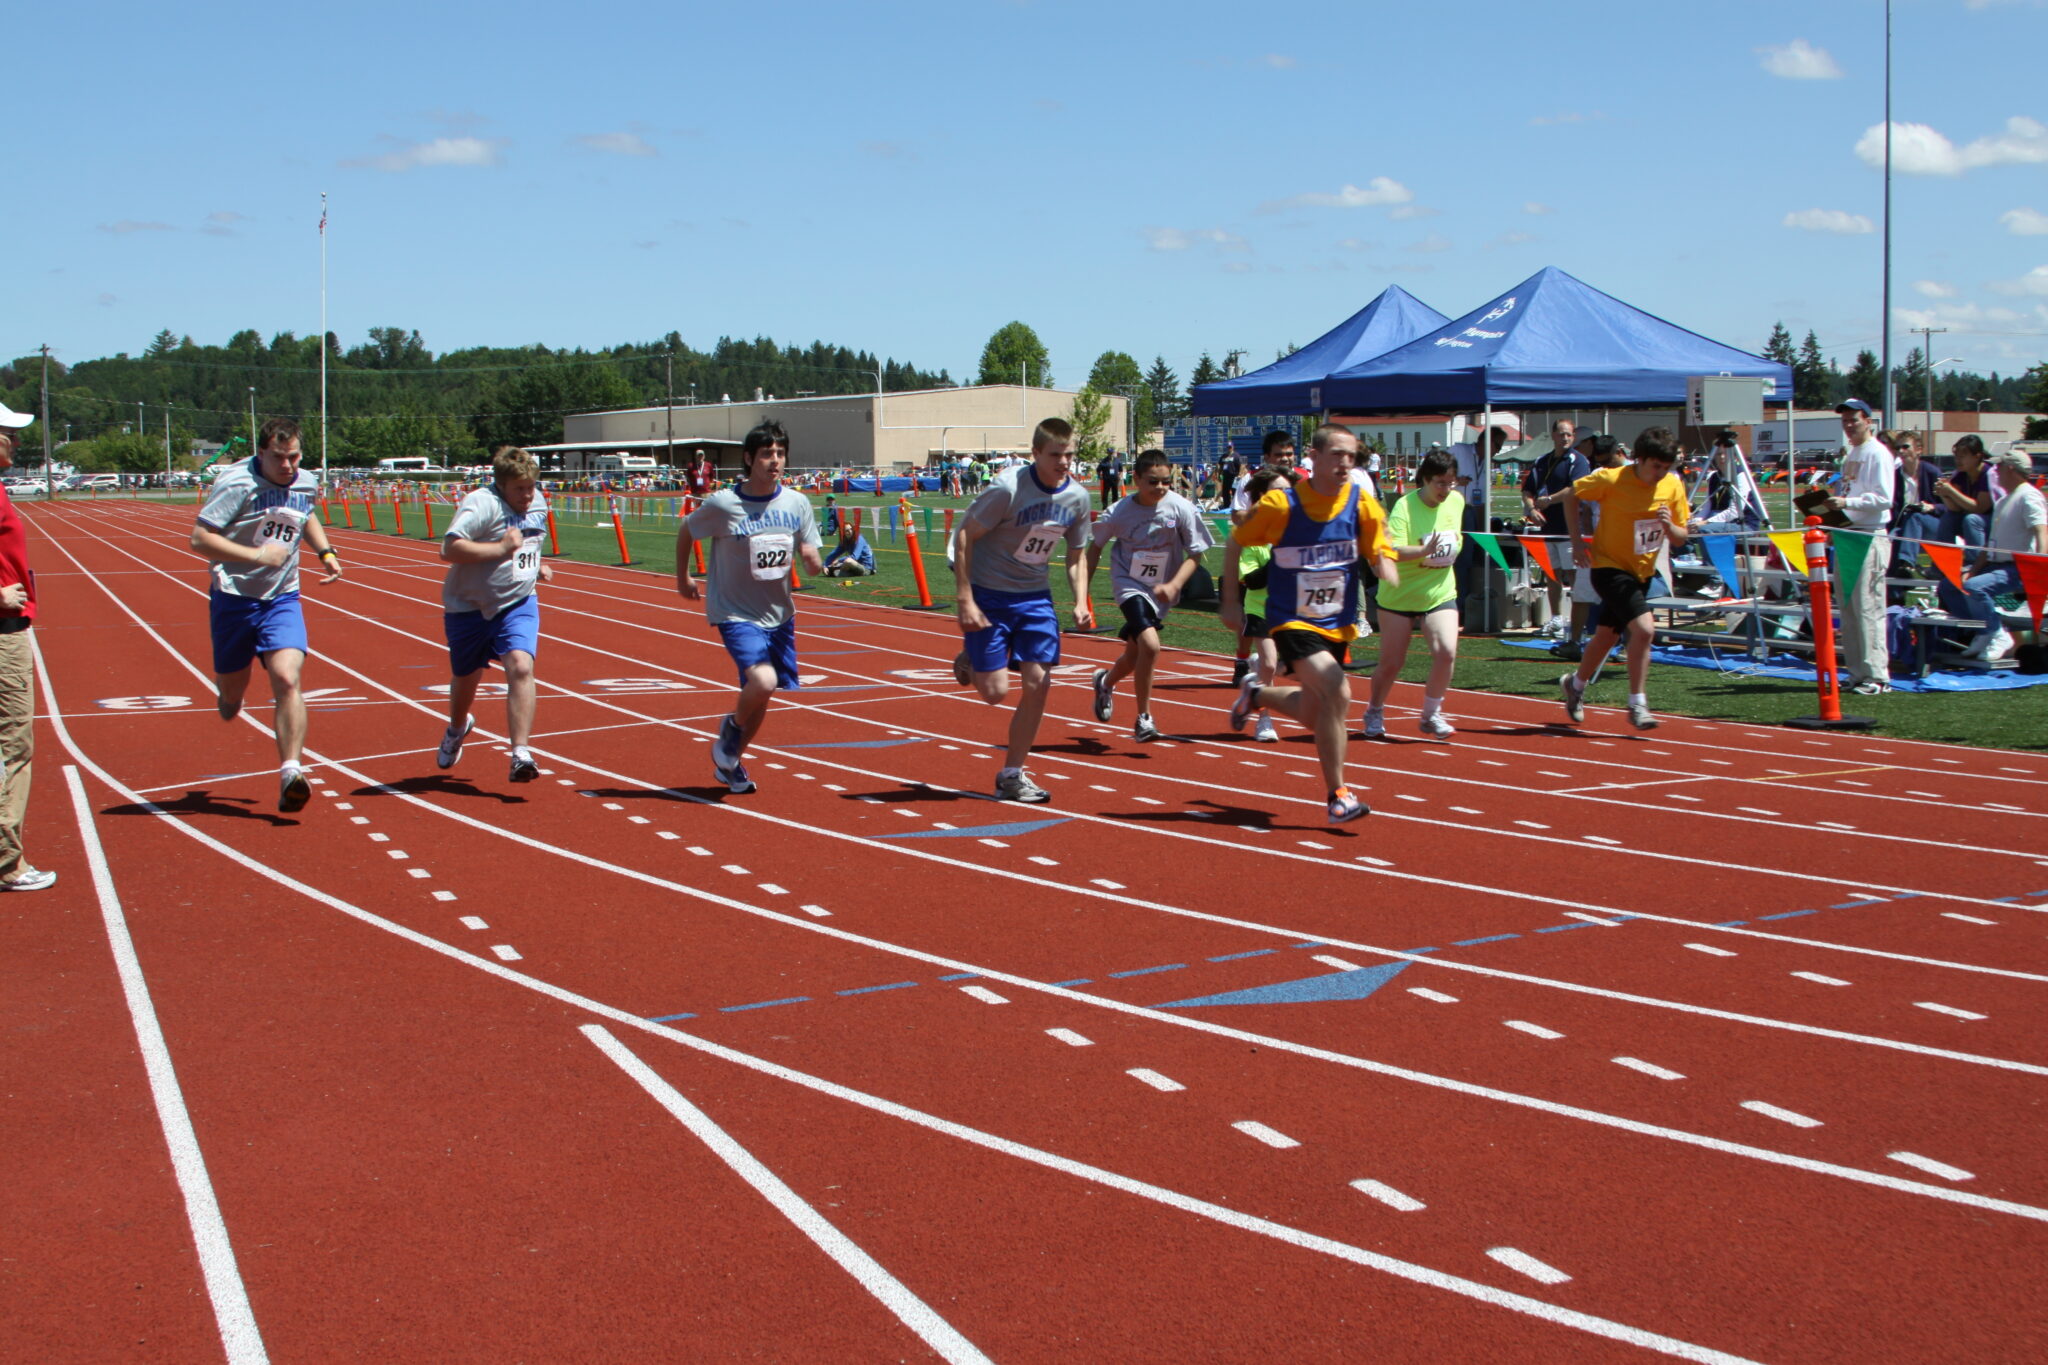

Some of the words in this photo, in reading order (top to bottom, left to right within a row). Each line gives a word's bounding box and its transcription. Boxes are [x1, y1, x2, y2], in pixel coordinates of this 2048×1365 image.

[262, 520, 296, 543] 315
[1640, 529, 1662, 546] 147
[1024, 537, 1054, 555] 314
[1298, 543, 1354, 567] TAHOMA
[518, 552, 536, 570] 311
[757, 550, 787, 569] 322
[1140, 564, 1159, 577] 75
